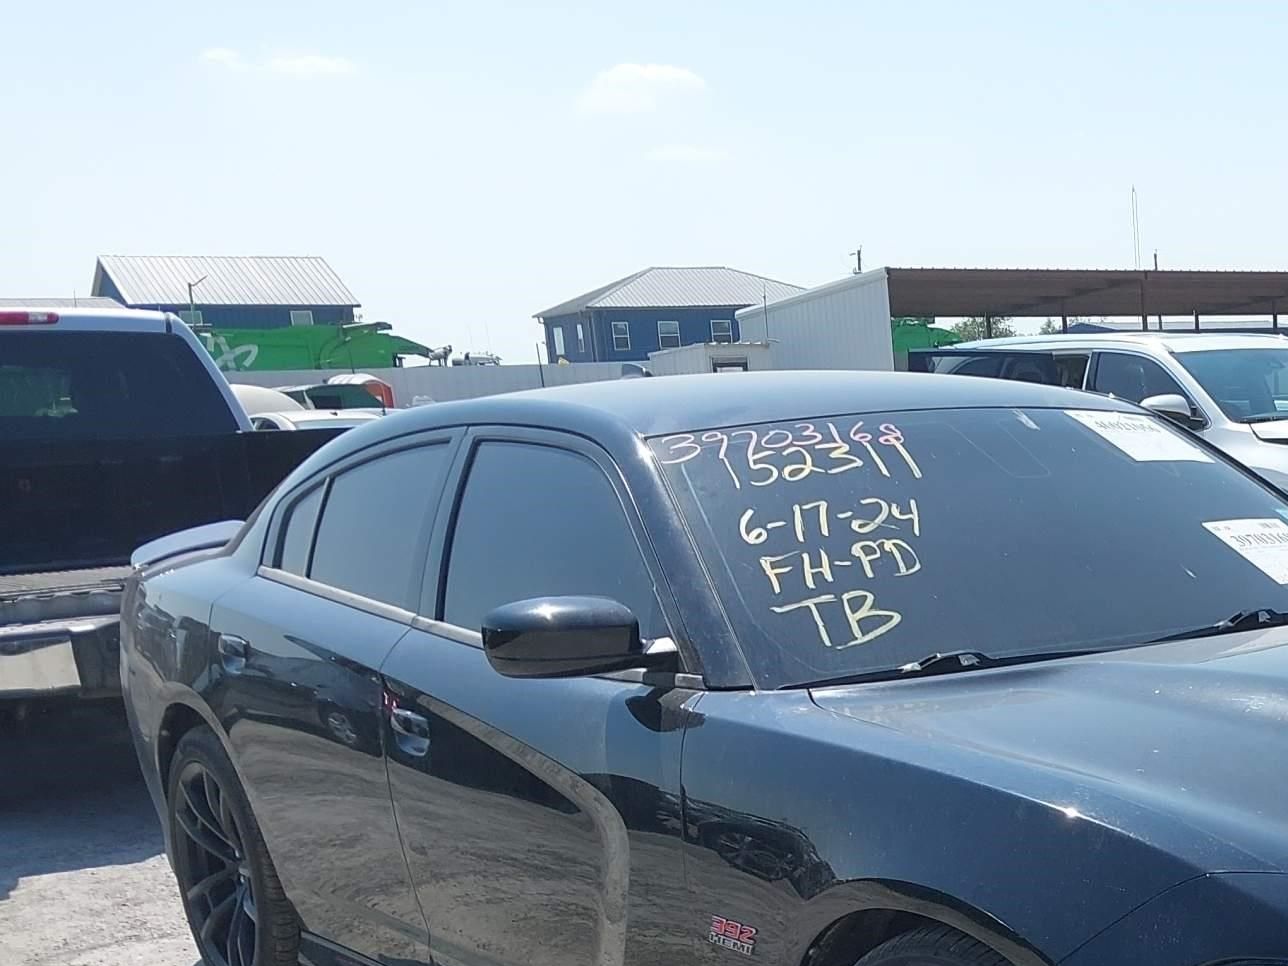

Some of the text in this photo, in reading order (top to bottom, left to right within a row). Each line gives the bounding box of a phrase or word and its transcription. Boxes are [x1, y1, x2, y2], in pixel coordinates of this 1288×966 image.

[661, 421, 904, 464] 39703168
[739, 497, 920, 545] 6-17-24
[759, 538, 921, 594] FH-PD
[769, 590, 901, 650] TB
[708, 932, 753, 956] HEMI
[711, 914, 758, 945] 392
